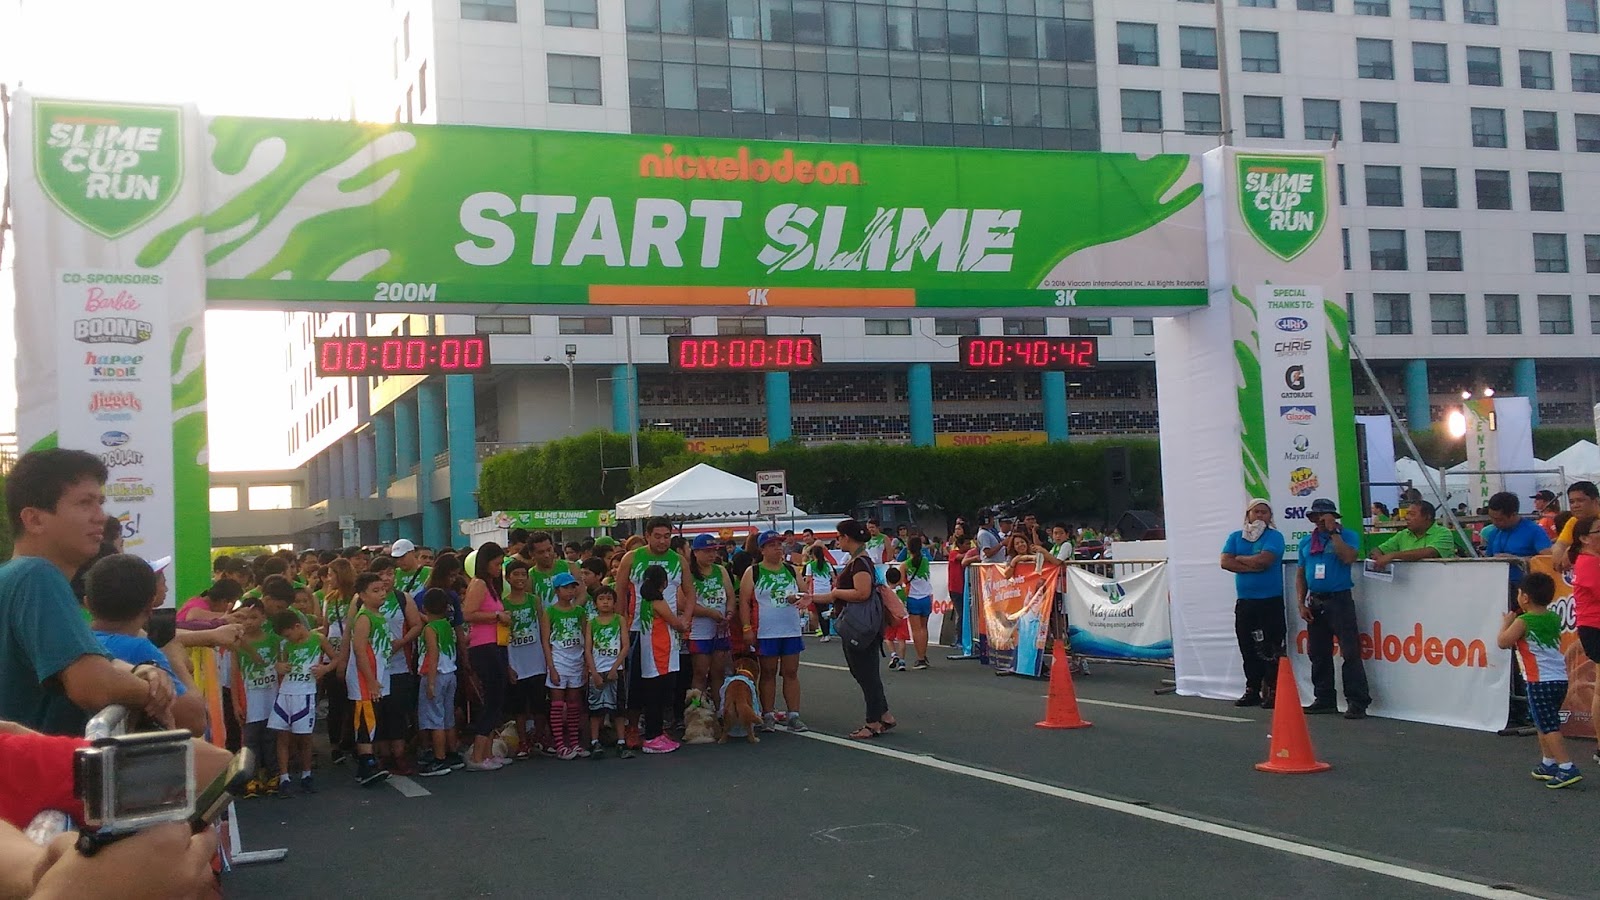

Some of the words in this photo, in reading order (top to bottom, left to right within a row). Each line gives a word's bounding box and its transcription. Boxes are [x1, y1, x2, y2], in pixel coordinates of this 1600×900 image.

[47, 122, 162, 151] SLIME
[61, 147, 139, 174] CUP
[639, 143, 861, 186] nickelodeon
[86, 172, 160, 201] RUN
[1245, 172, 1314, 193] SLIME
[1253, 191, 1302, 211] CUP
[1268, 210, 1315, 231] RUN
[454, 191, 743, 268] START
[756, 203, 1022, 275] SLIME
[62, 273, 163, 285] CO-SPONSORS:
[1067, 279, 1092, 287] Viacom
[1093, 279, 1133, 287] International
[1157, 279, 1175, 289] Rights
[84, 286, 142, 312] Barbie
[374, 282, 438, 302] 200M
[747, 288, 770, 306] 1K
[1054, 289, 1078, 307] 3K
[1273, 289, 1307, 297] SPECIAL
[1268, 301, 1300, 309] THANKS
[1301, 301, 1315, 309] TO:
[322, 339, 484, 371] 00:00:00
[680, 339, 814, 368] 00:00:00
[969, 340, 1094, 366] 00:40:42
[93, 366, 136, 377] KIDDIE
[1285, 365, 1306, 391] G
[953, 435, 992, 447] SMDC
[1284, 452, 1320, 461] Maynilad
[1475, 420, 1491, 508] ENTRANC
[544, 518, 578, 526] SHOWER
[1089, 603, 1135, 621] Maynilad
[1296, 620, 1488, 668] nelodeon
[252, 674, 277, 687] 1002
[289, 673, 312, 682] 1125
